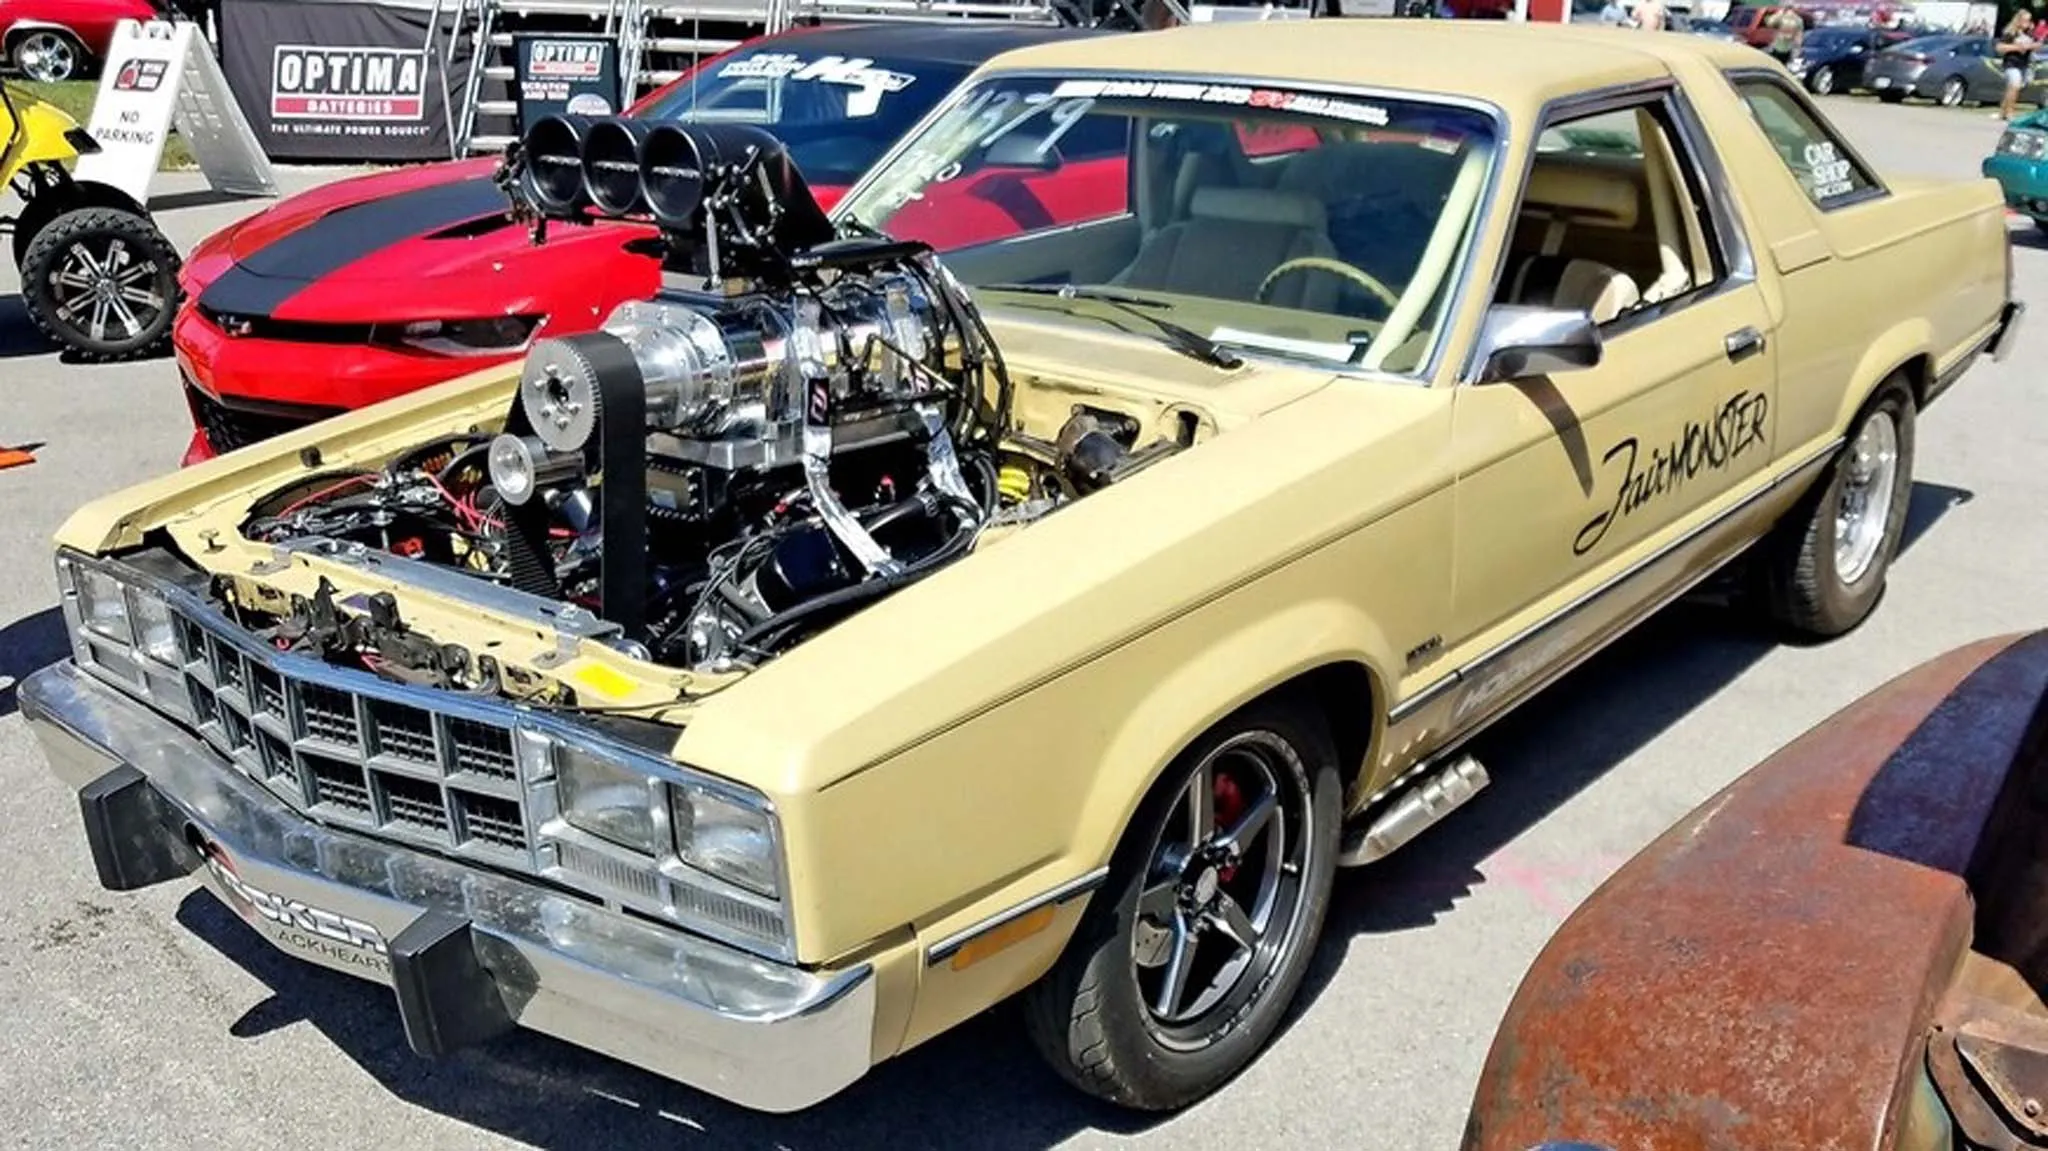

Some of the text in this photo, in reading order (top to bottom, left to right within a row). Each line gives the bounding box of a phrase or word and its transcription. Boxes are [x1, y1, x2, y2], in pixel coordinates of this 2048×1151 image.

[534, 45, 598, 61] OPTIMA
[279, 54, 417, 92] OPTIMA
[307, 100, 393, 114] BATTERIES
[119, 111, 141, 123] NO
[95, 127, 155, 145] PARKING
[271, 123, 290, 133] THE
[293, 124, 341, 134] ULTIMATE
[345, 125, 382, 135] POWER
[1804, 142, 1836, 167] CAR
[1812, 158, 1852, 184] SHOP
